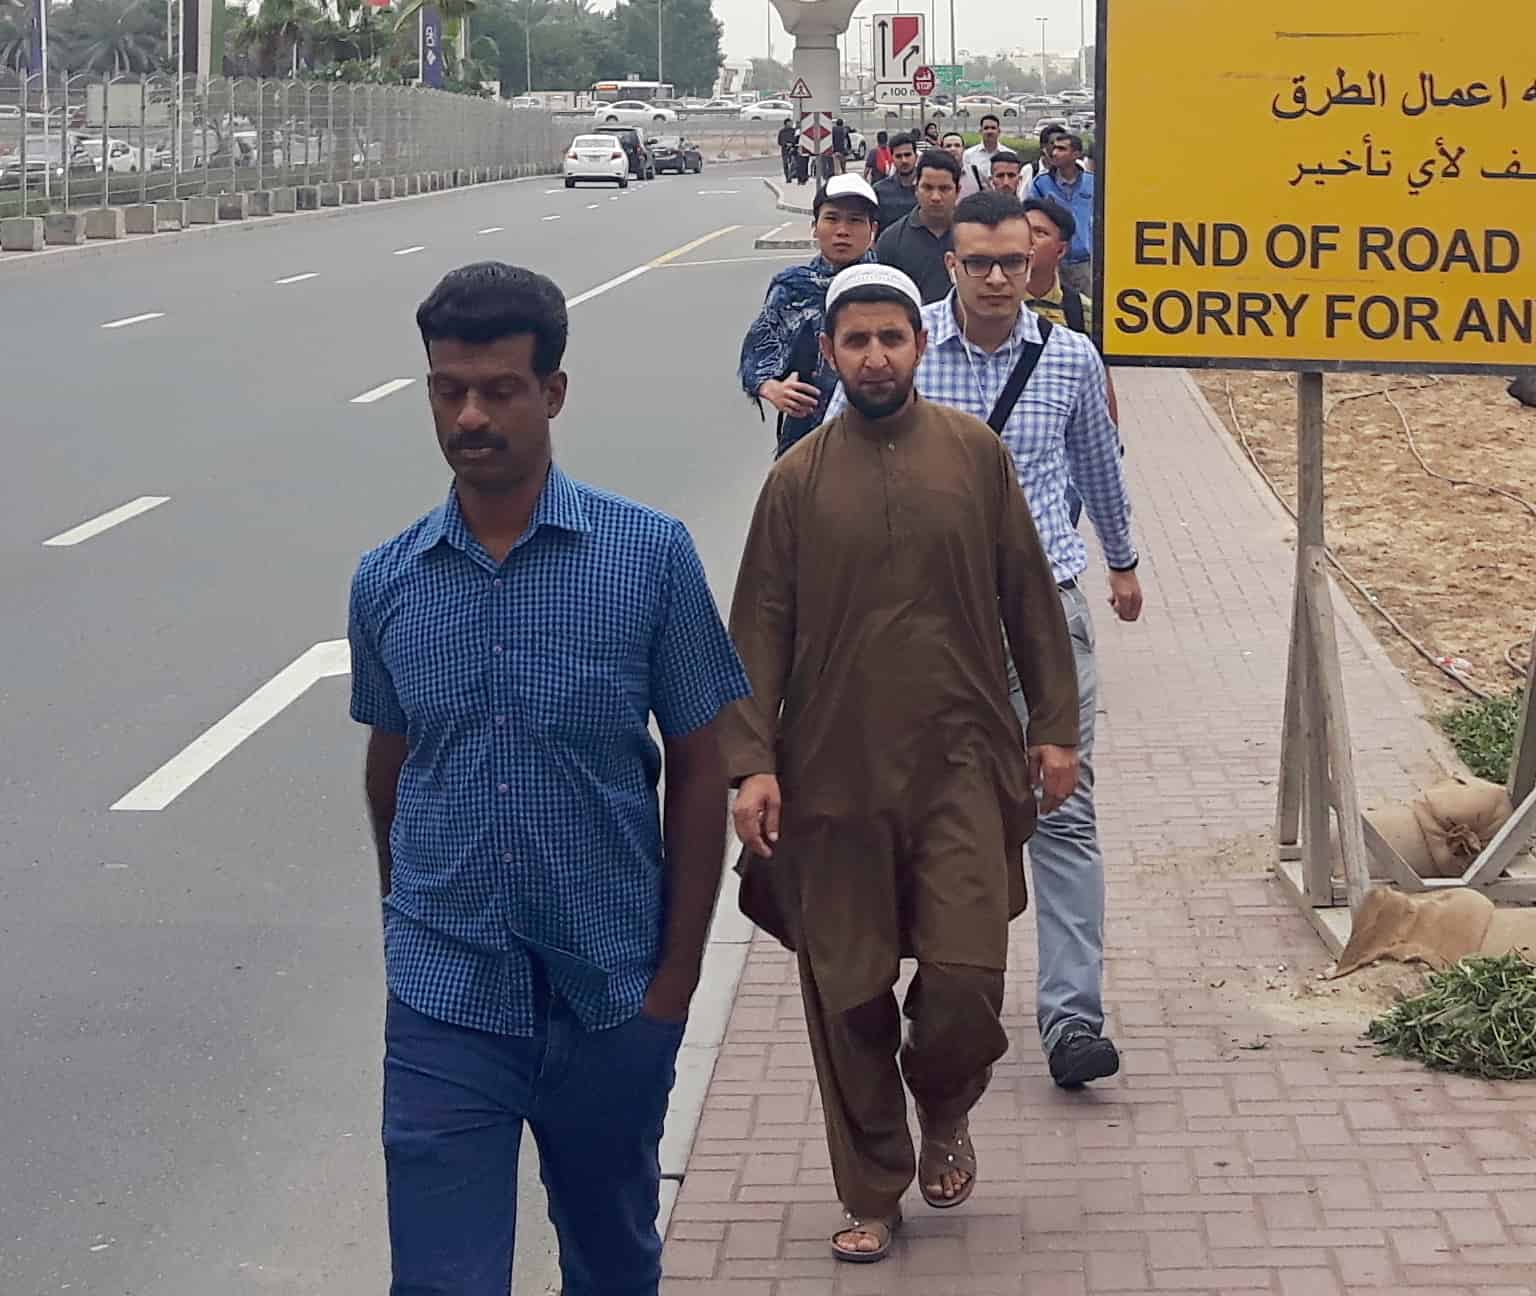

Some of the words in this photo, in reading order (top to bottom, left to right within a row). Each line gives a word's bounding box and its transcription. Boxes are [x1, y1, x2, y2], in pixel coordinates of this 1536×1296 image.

[890, 88, 907, 96] 100
[1272, 68, 1385, 119] الطرق
[1402, 71, 1506, 116] اعمال
[1289, 134, 1391, 186] تأخير
[1408, 137, 1465, 195] لأي
[1135, 221, 1247, 267] END
[1266, 224, 1339, 270] OF
[1359, 227, 1519, 274] ROAD
[1115, 289, 1309, 338] SORRY
[1326, 295, 1440, 342] FOR
